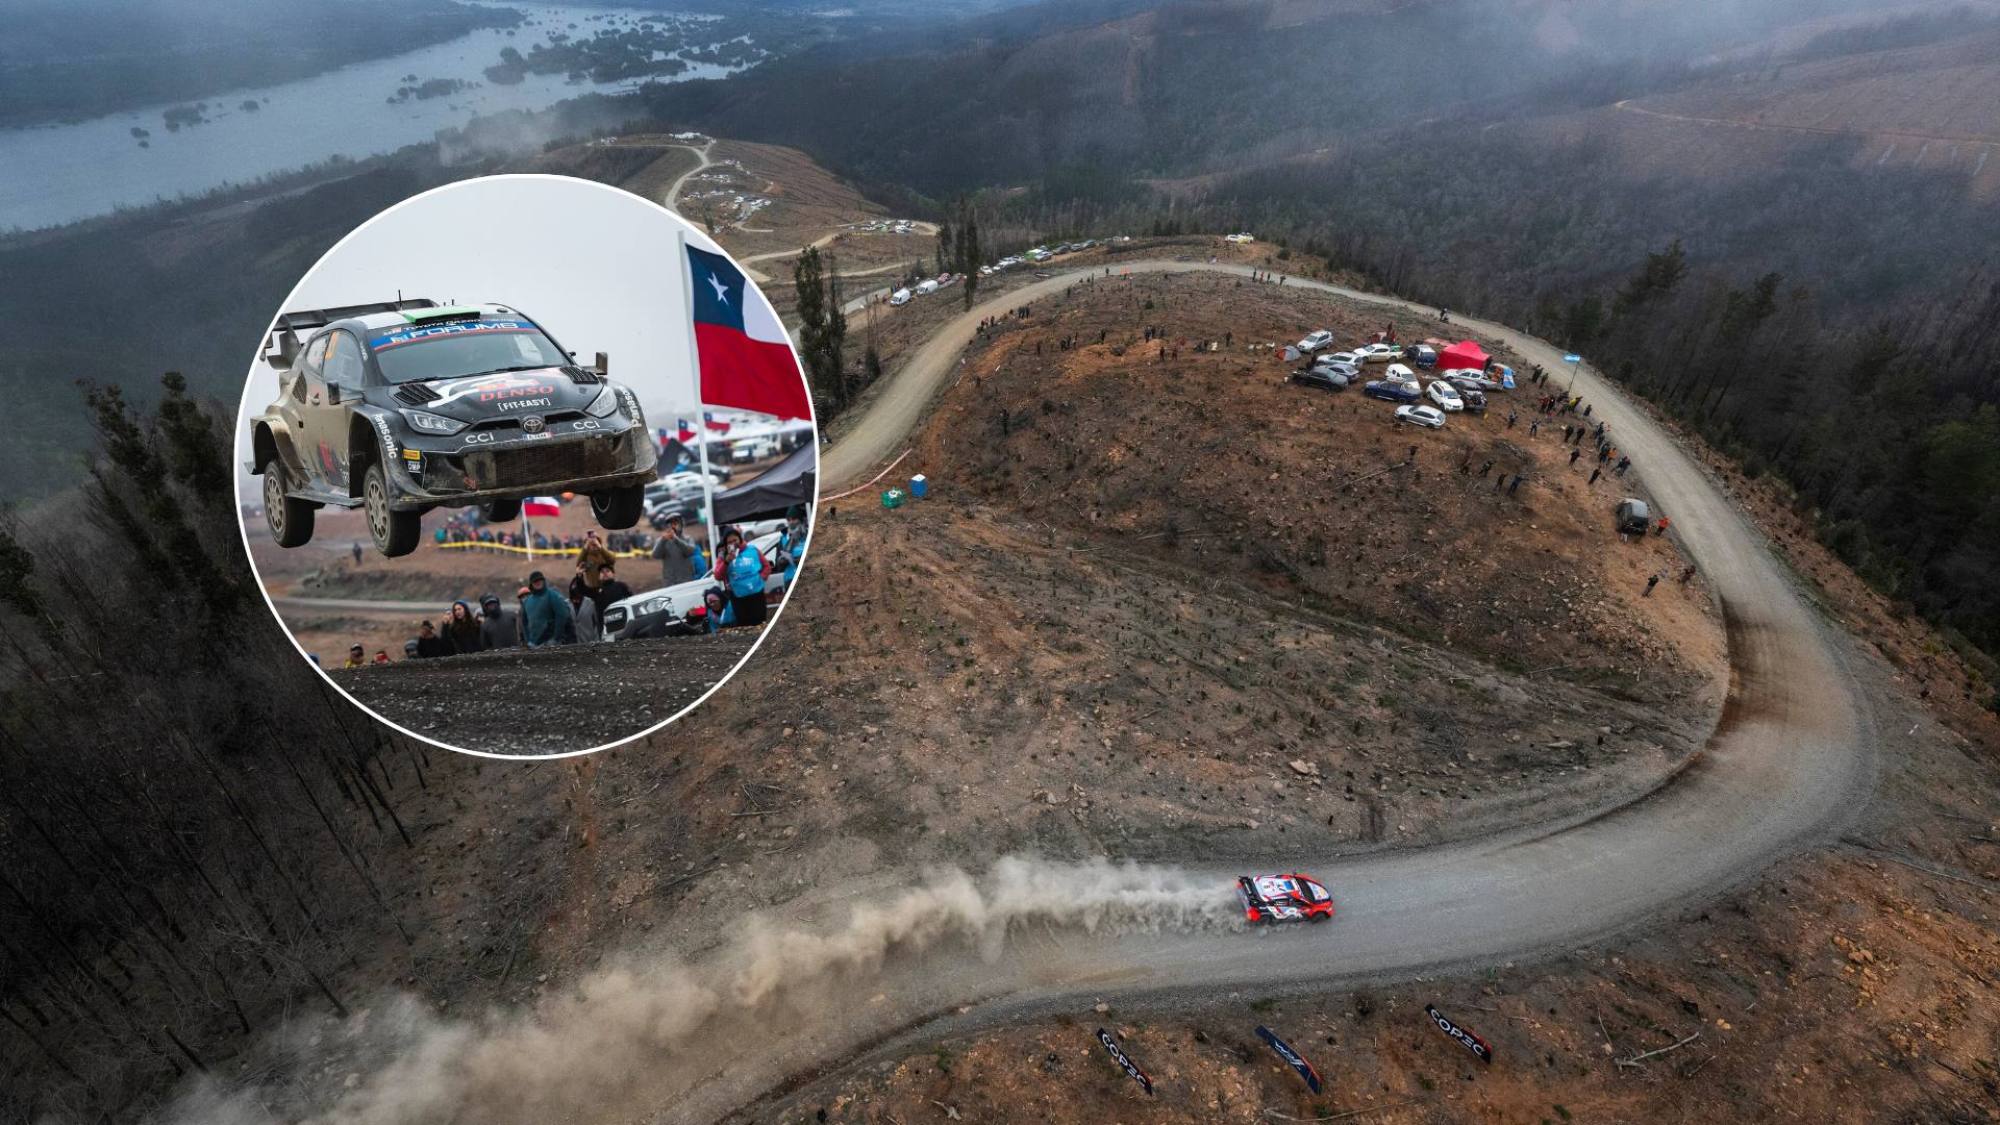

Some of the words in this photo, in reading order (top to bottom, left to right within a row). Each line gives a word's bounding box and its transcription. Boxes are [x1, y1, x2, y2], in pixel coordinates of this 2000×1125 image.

[480, 384, 555, 402] DENSO
[573, 420, 601, 430] CCI
[465, 431, 495, 444] CCI
[1431, 1008, 1485, 1056] COPEC
[1102, 1033, 1146, 1088] COPEC
